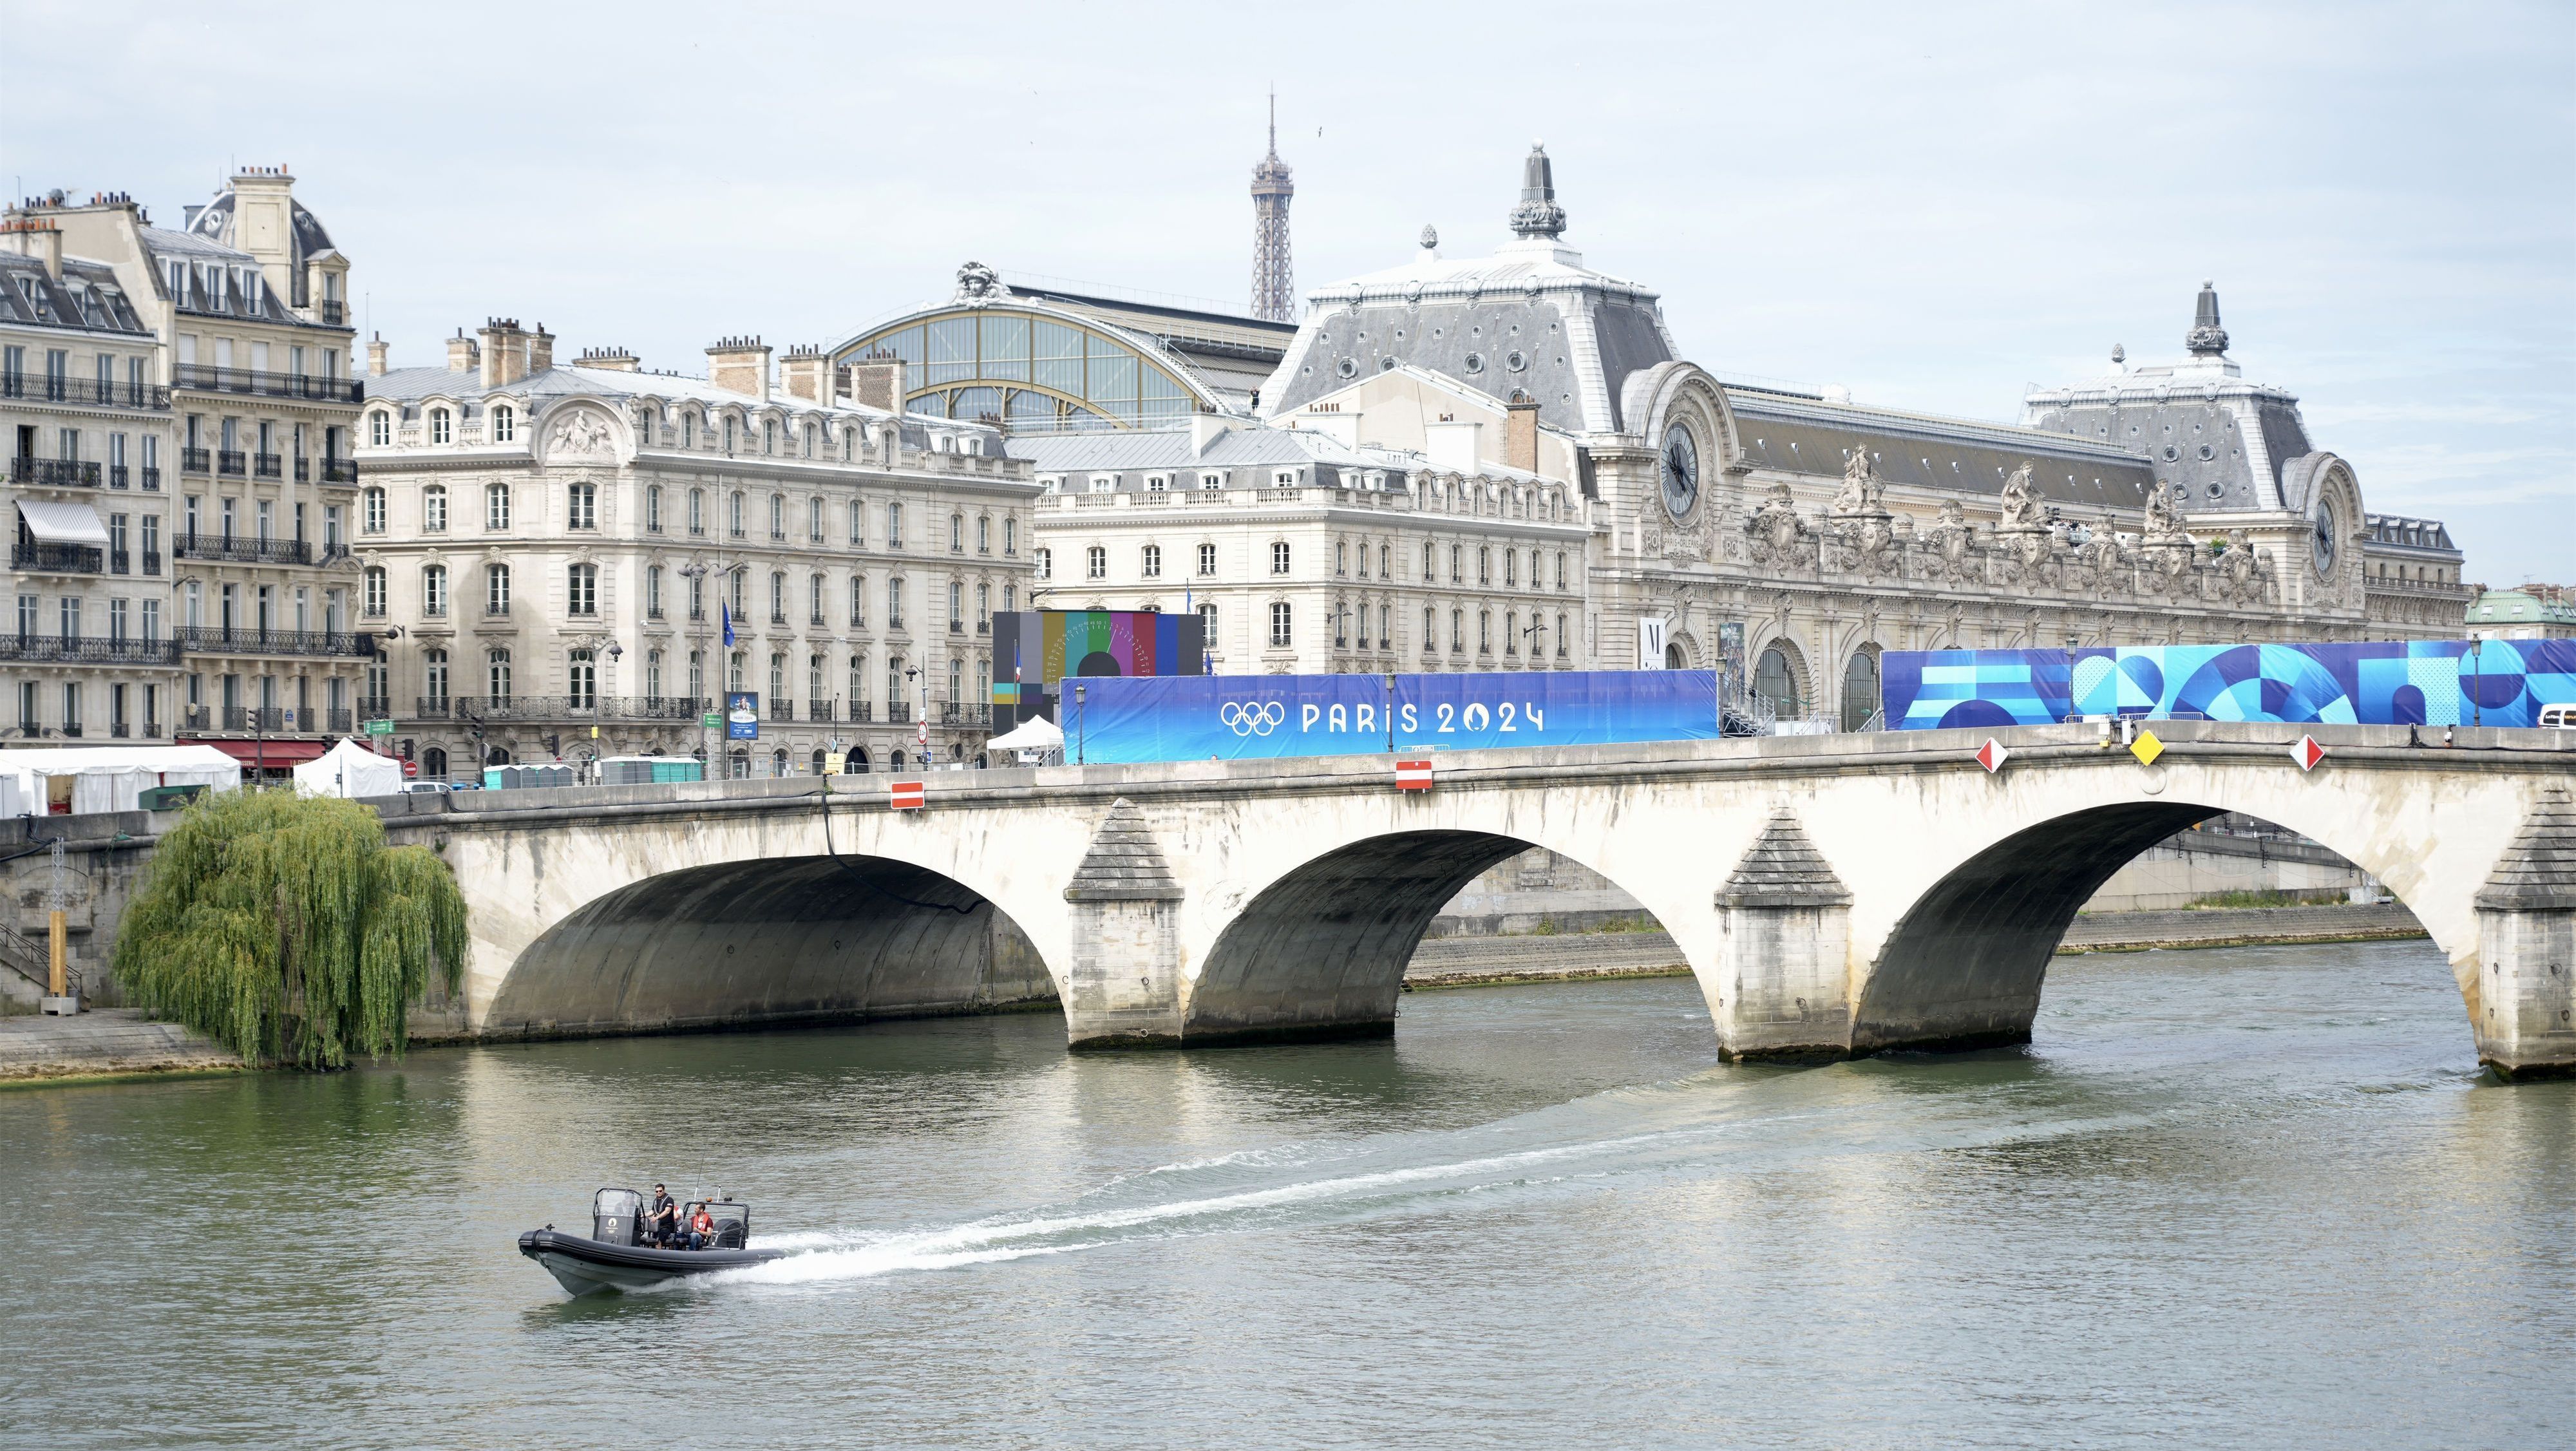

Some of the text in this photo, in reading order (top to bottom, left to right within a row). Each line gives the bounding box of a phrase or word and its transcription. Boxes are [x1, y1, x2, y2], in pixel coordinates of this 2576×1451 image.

[1646, 535, 1658, 547] PO
[1727, 541, 1737, 554] PO
[1751, 594, 1769, 604] RODEZ
[1302, 701, 1544, 734] PARIS 2024
